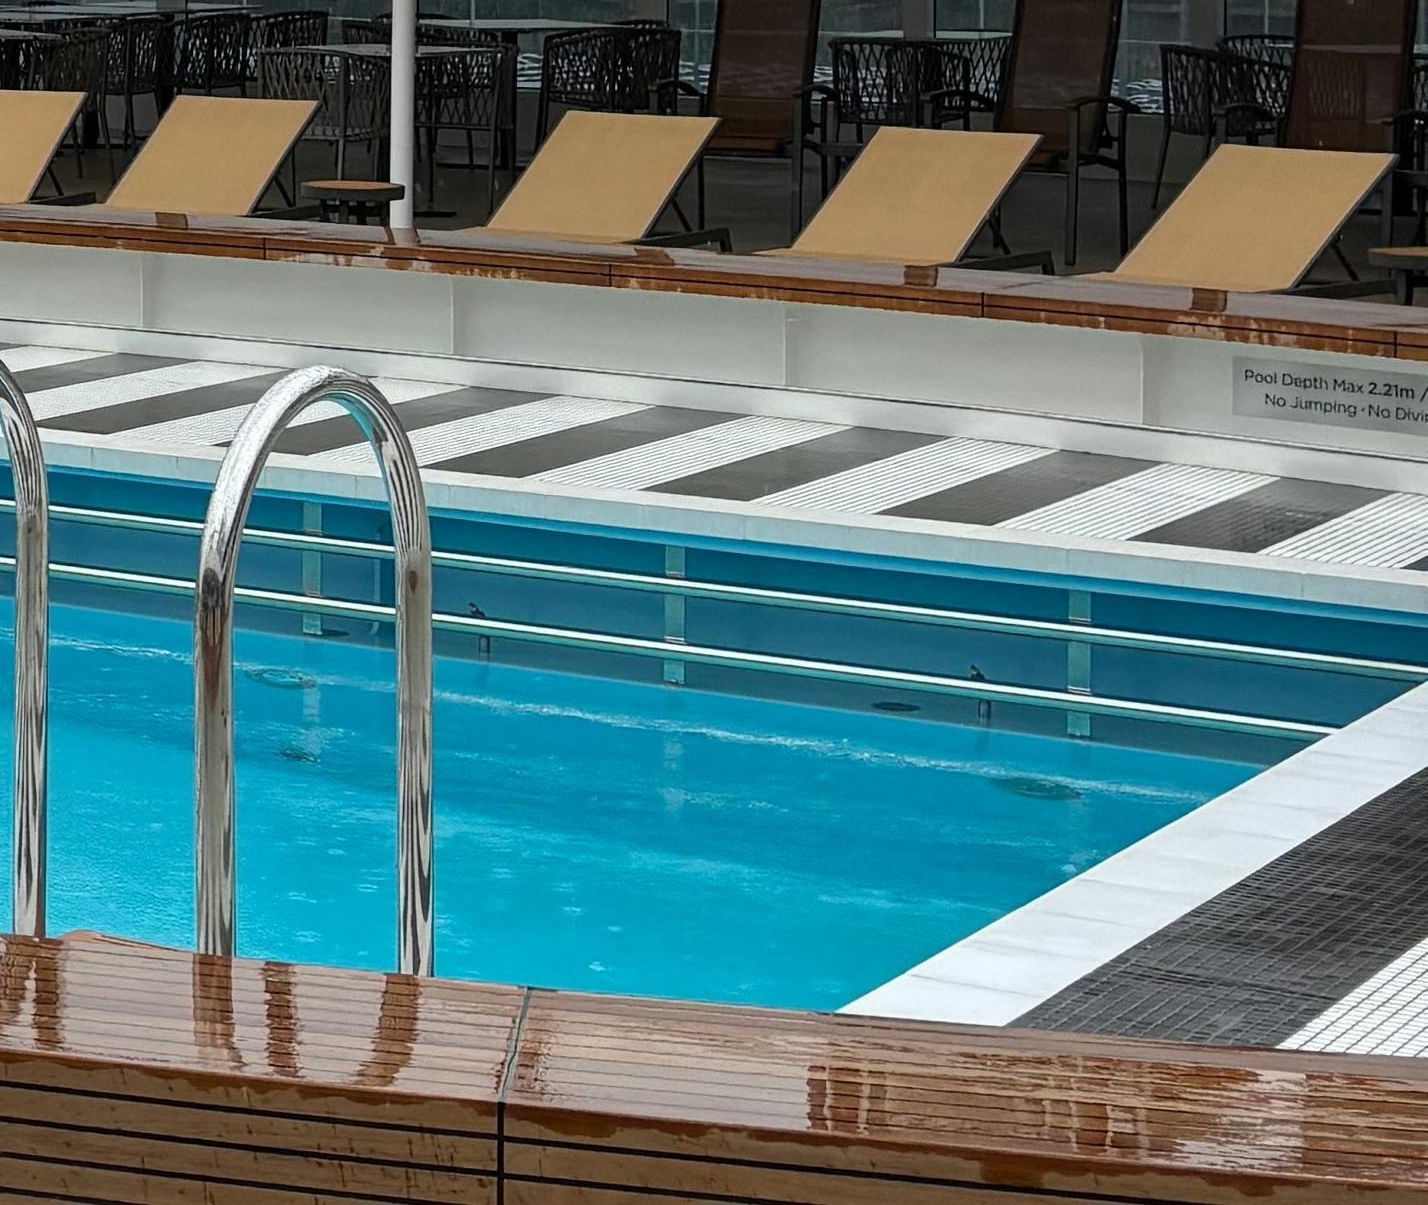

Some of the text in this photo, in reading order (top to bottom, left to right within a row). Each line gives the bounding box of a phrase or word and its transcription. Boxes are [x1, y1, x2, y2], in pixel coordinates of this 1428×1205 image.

[1244, 369, 1277, 384] Pool
[1282, 373, 1329, 391] Depth
[1333, 379, 1364, 393] Max
[1369, 382, 1415, 400] 2.21m
[1265, 394, 1286, 407] No
[1290, 397, 1357, 417] Jumping
[1368, 404, 1391, 419] No
